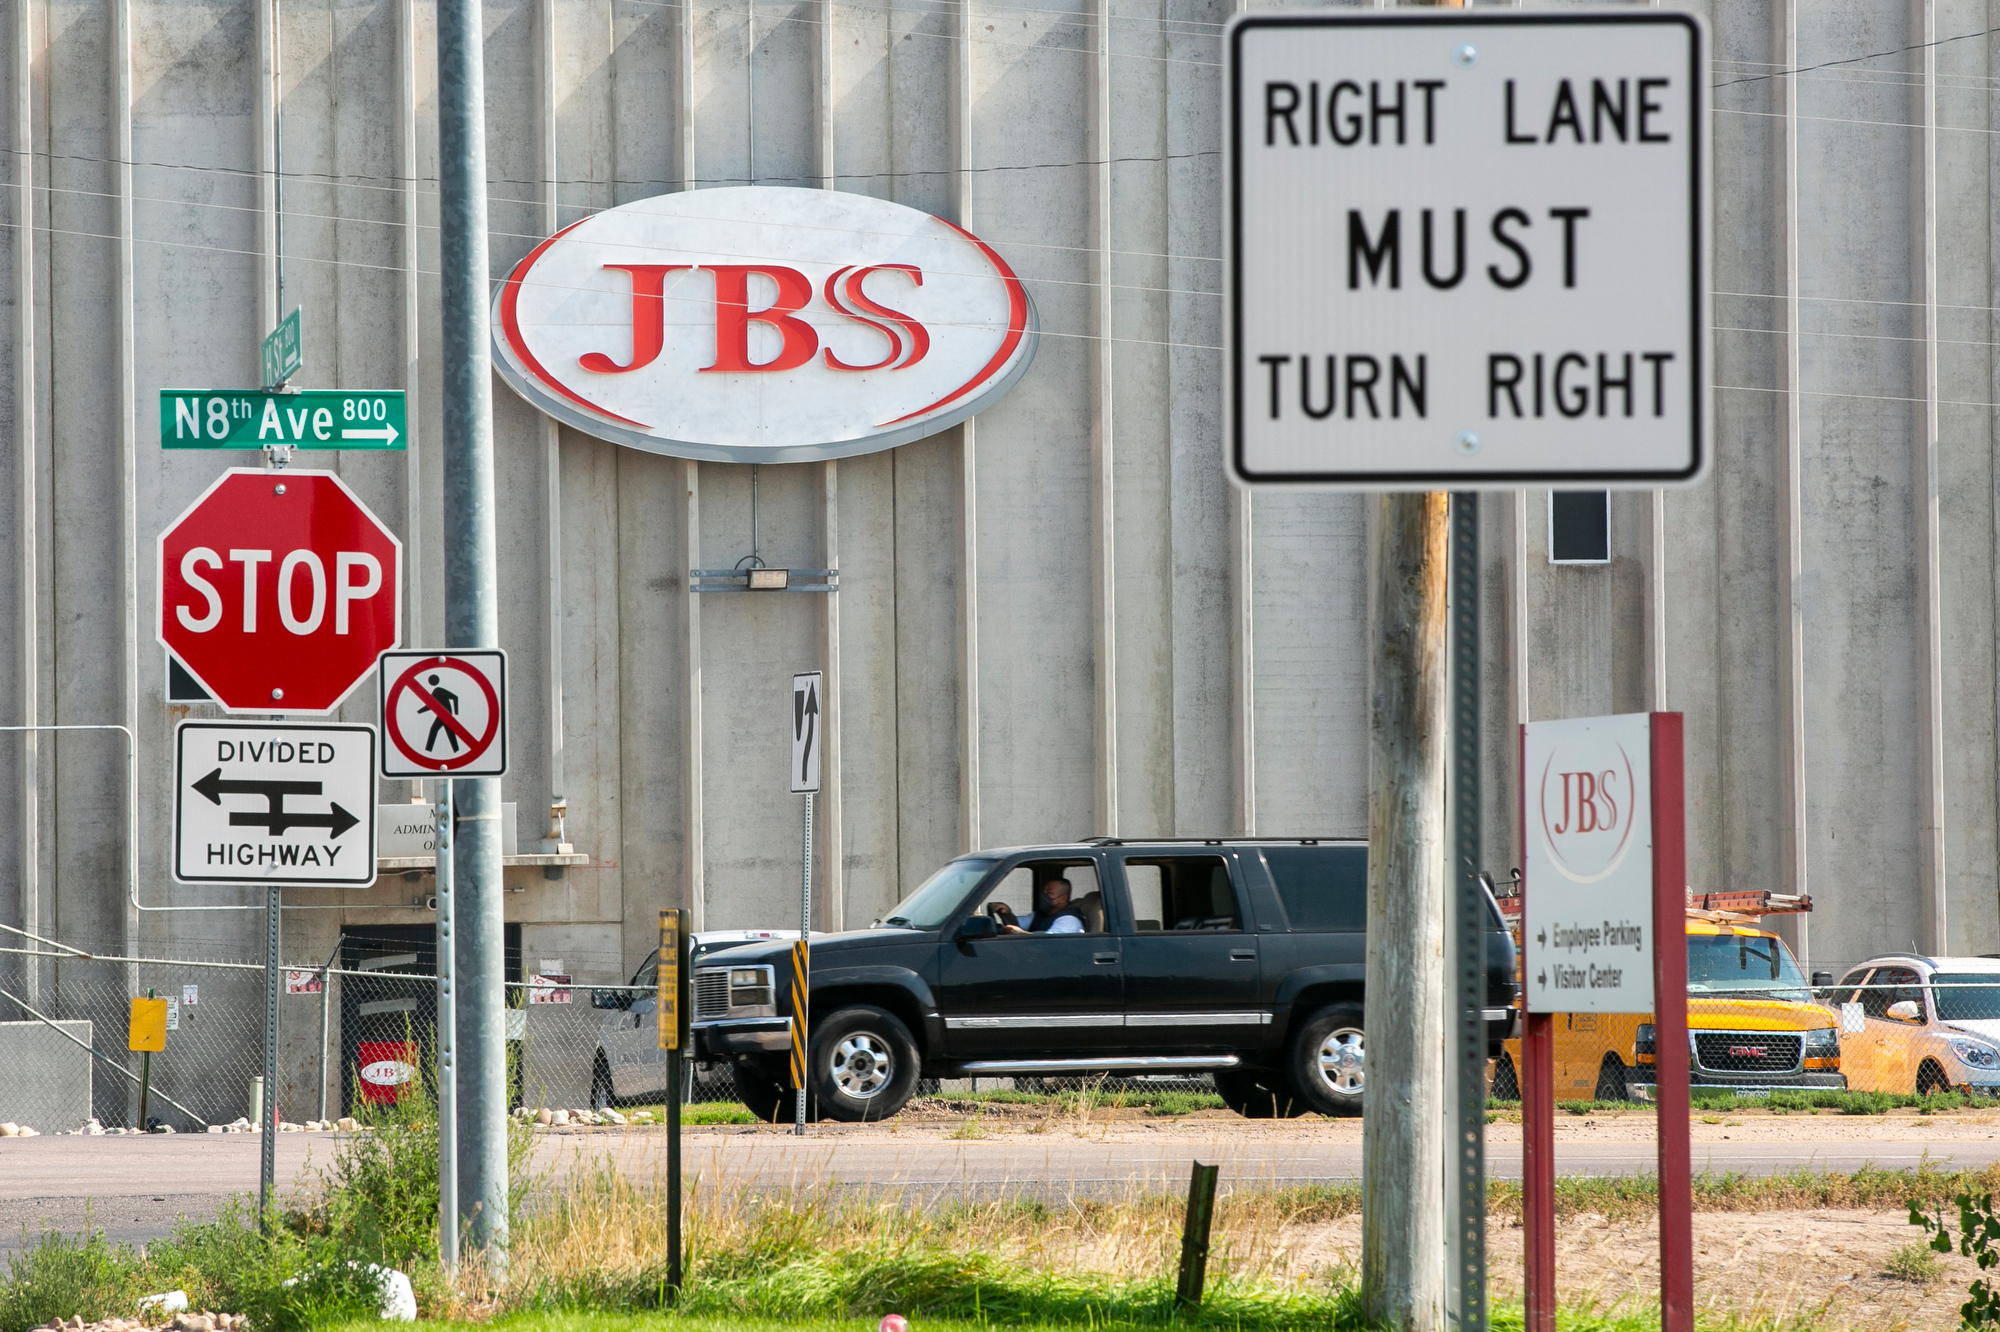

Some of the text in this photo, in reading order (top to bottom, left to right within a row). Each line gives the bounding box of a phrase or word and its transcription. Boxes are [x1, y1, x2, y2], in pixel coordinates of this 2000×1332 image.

[1266, 78, 1671, 146] RIGHT LANE
[1347, 208, 1590, 290] MUST
[578, 263, 930, 374] JBS
[1258, 353, 1675, 420] TURN RIGHT
[258, 398, 334, 440] Ave
[342, 399, 387, 420] 800
[176, 547, 383, 635] STOP
[218, 741, 335, 763] DIVIDED
[1554, 769, 1617, 835] JBS
[207, 843, 342, 867] HIGHWAY
[1553, 919, 1642, 954] Employee Parking
[1552, 962, 1623, 989] Visitor Center
[1729, 1046, 1768, 1058] GMC
